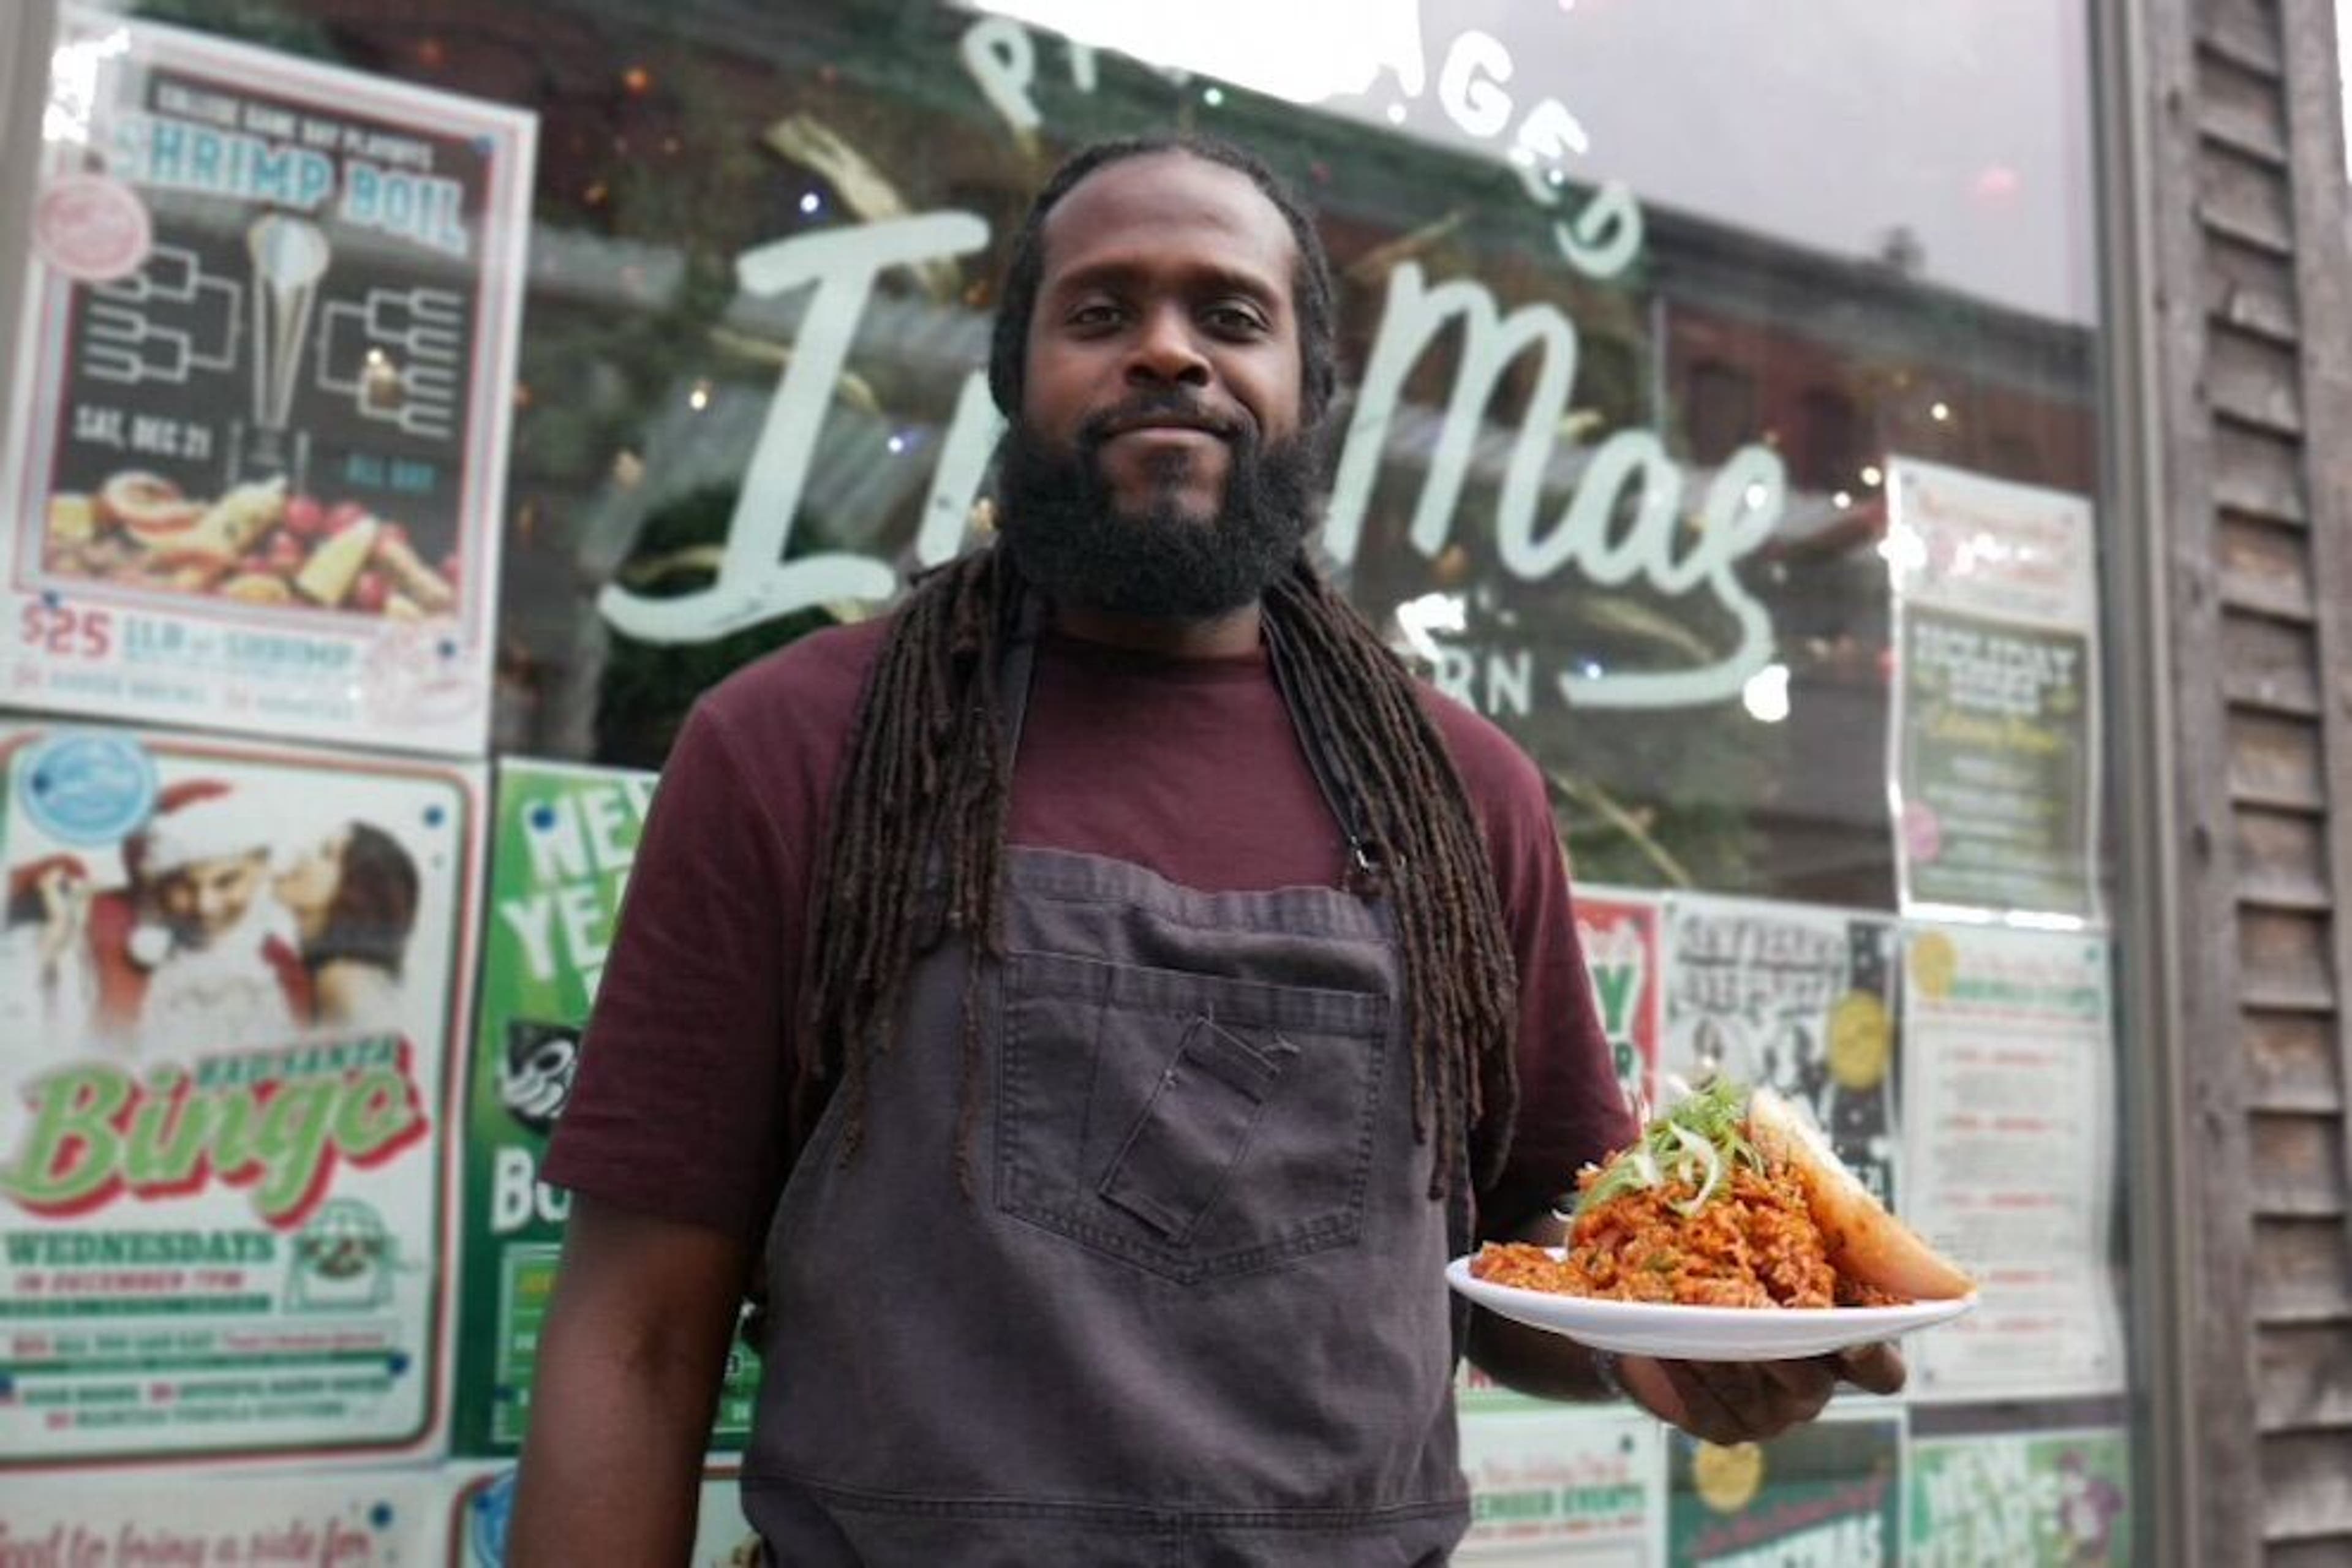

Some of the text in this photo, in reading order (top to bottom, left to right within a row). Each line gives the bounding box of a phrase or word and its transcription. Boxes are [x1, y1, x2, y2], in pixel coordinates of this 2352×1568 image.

[110, 121, 469, 255] SHRIMP BOIL
[20, 603, 112, 659] $25
[0, 1061, 430, 1232] Bingo
[4, 1230, 276, 1265] WEDNESDAYS
